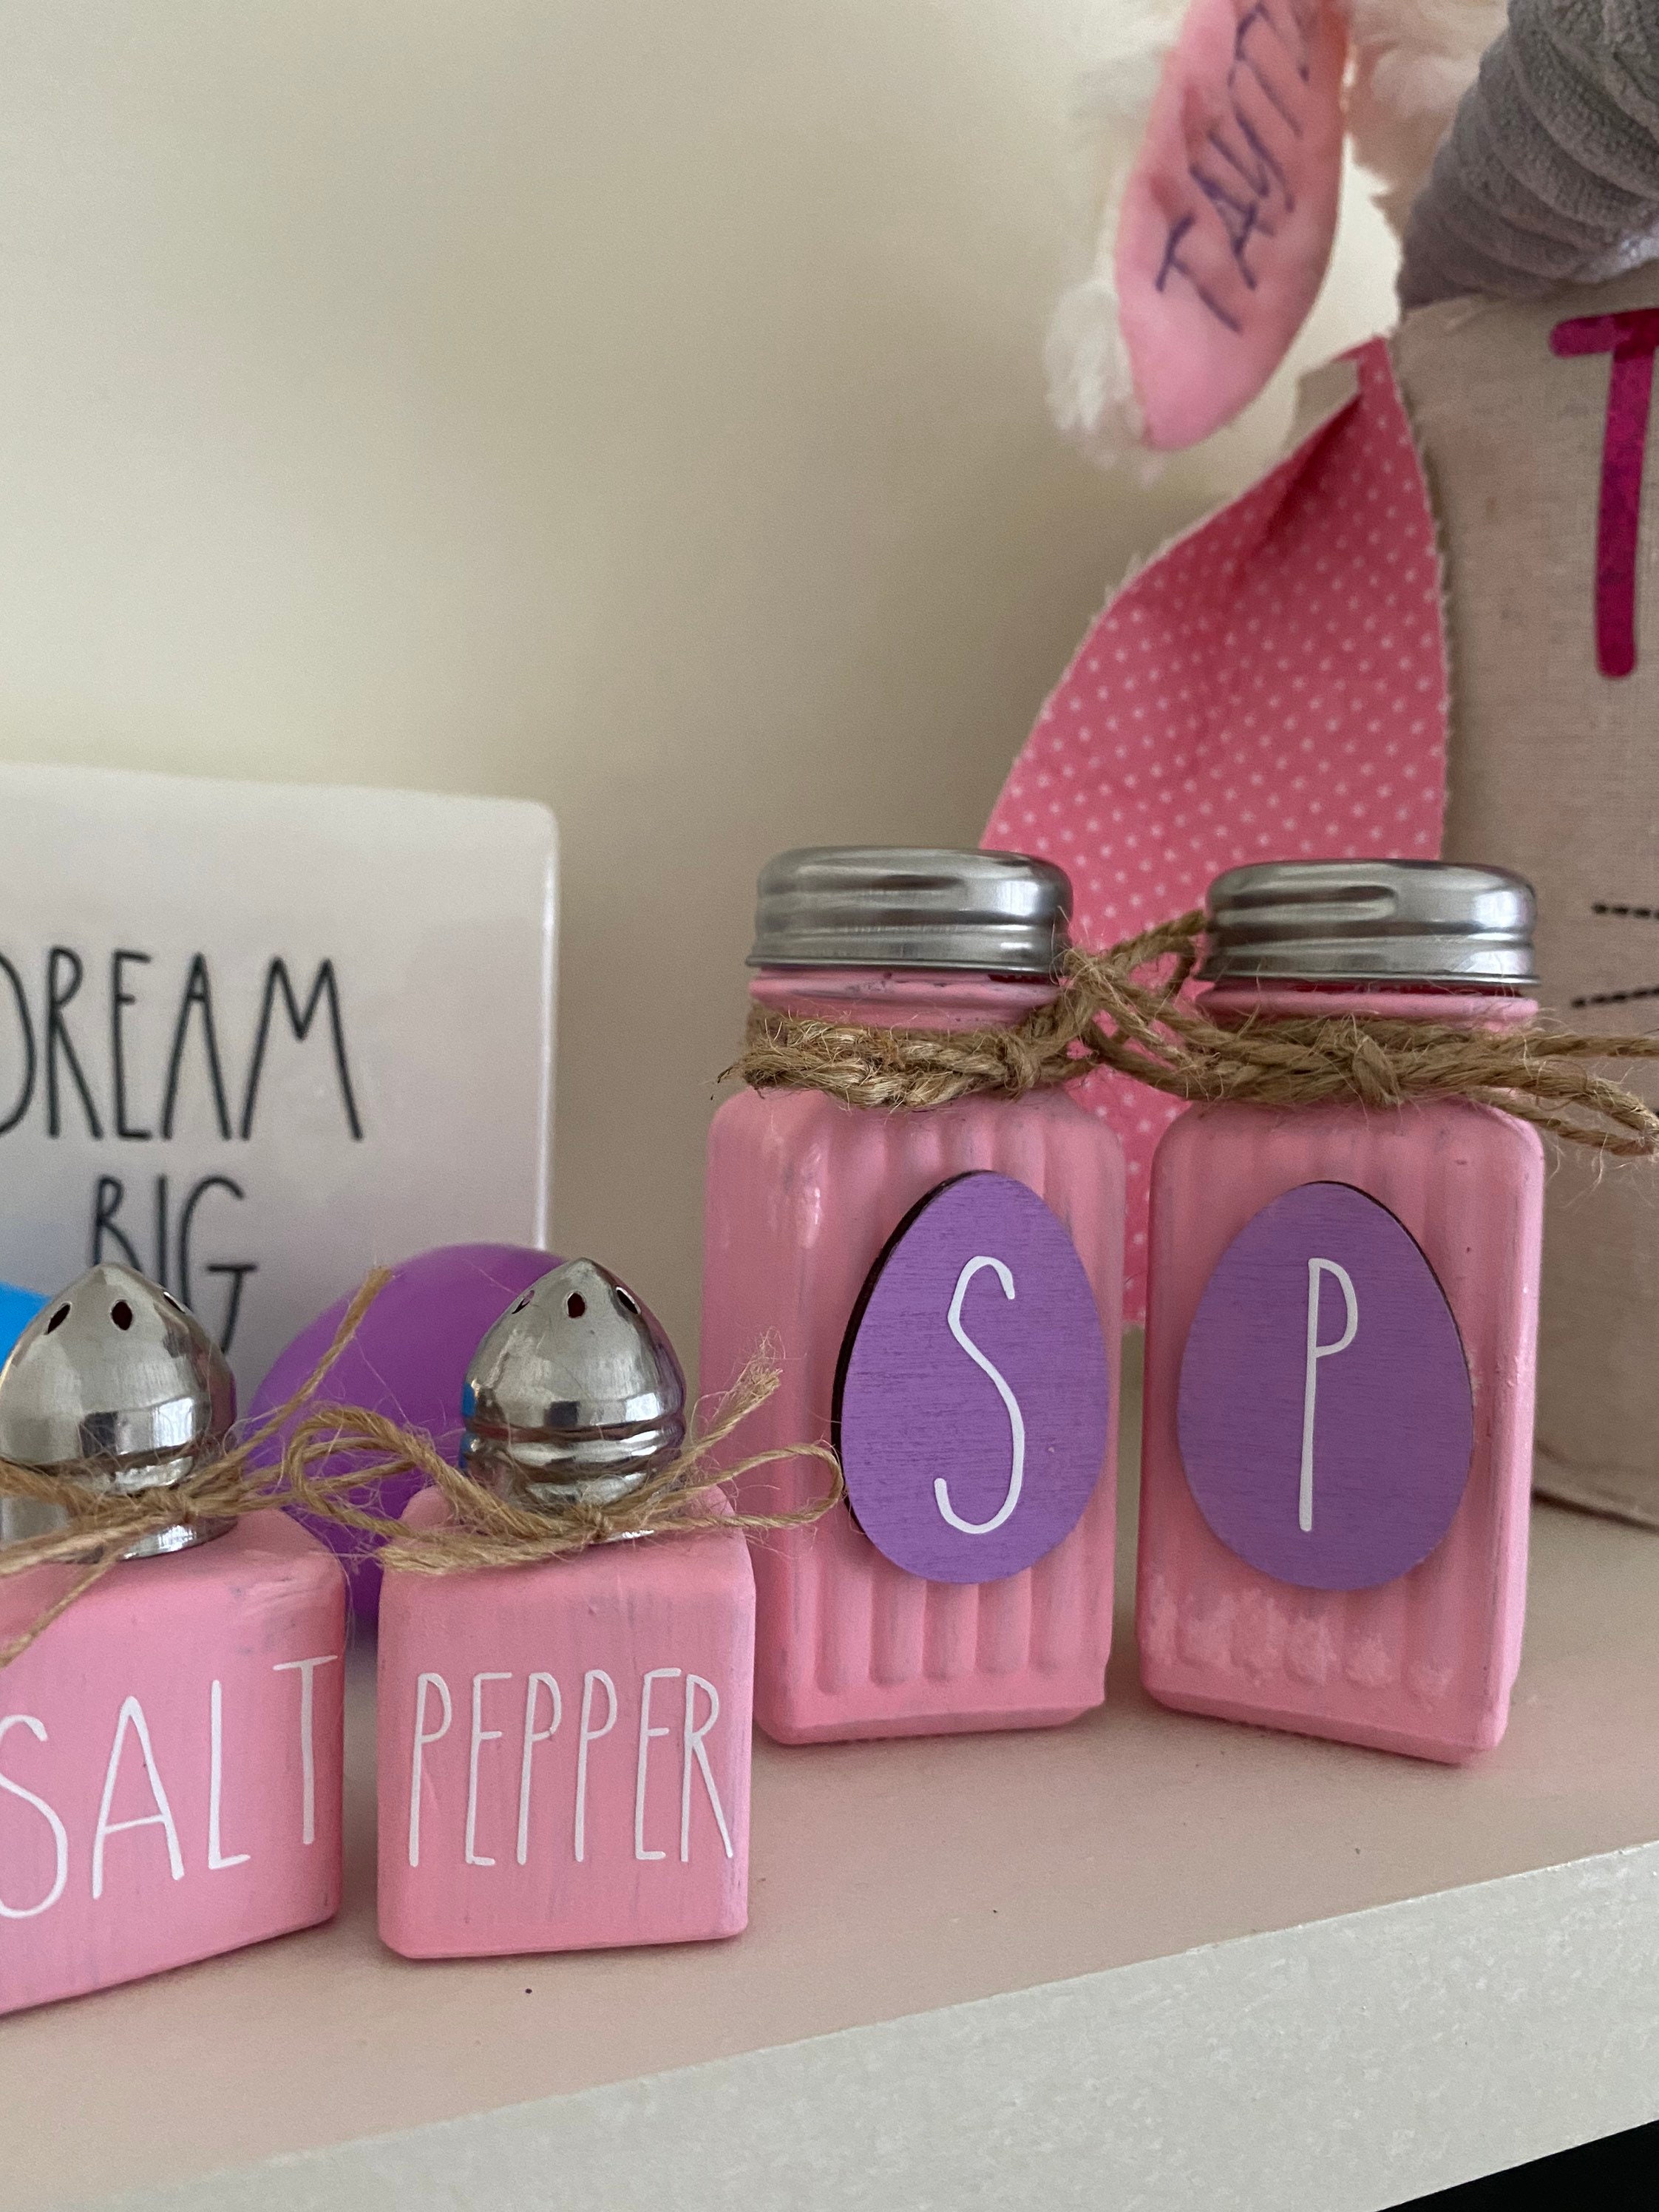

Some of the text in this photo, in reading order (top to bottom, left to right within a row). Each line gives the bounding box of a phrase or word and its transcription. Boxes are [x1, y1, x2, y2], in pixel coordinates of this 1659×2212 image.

[934, 1255, 1025, 1534] S
[1298, 1258, 1358, 1532] P
[0, 1655, 338, 1919] SALT
[408, 1667, 733, 1867] PEPPER
